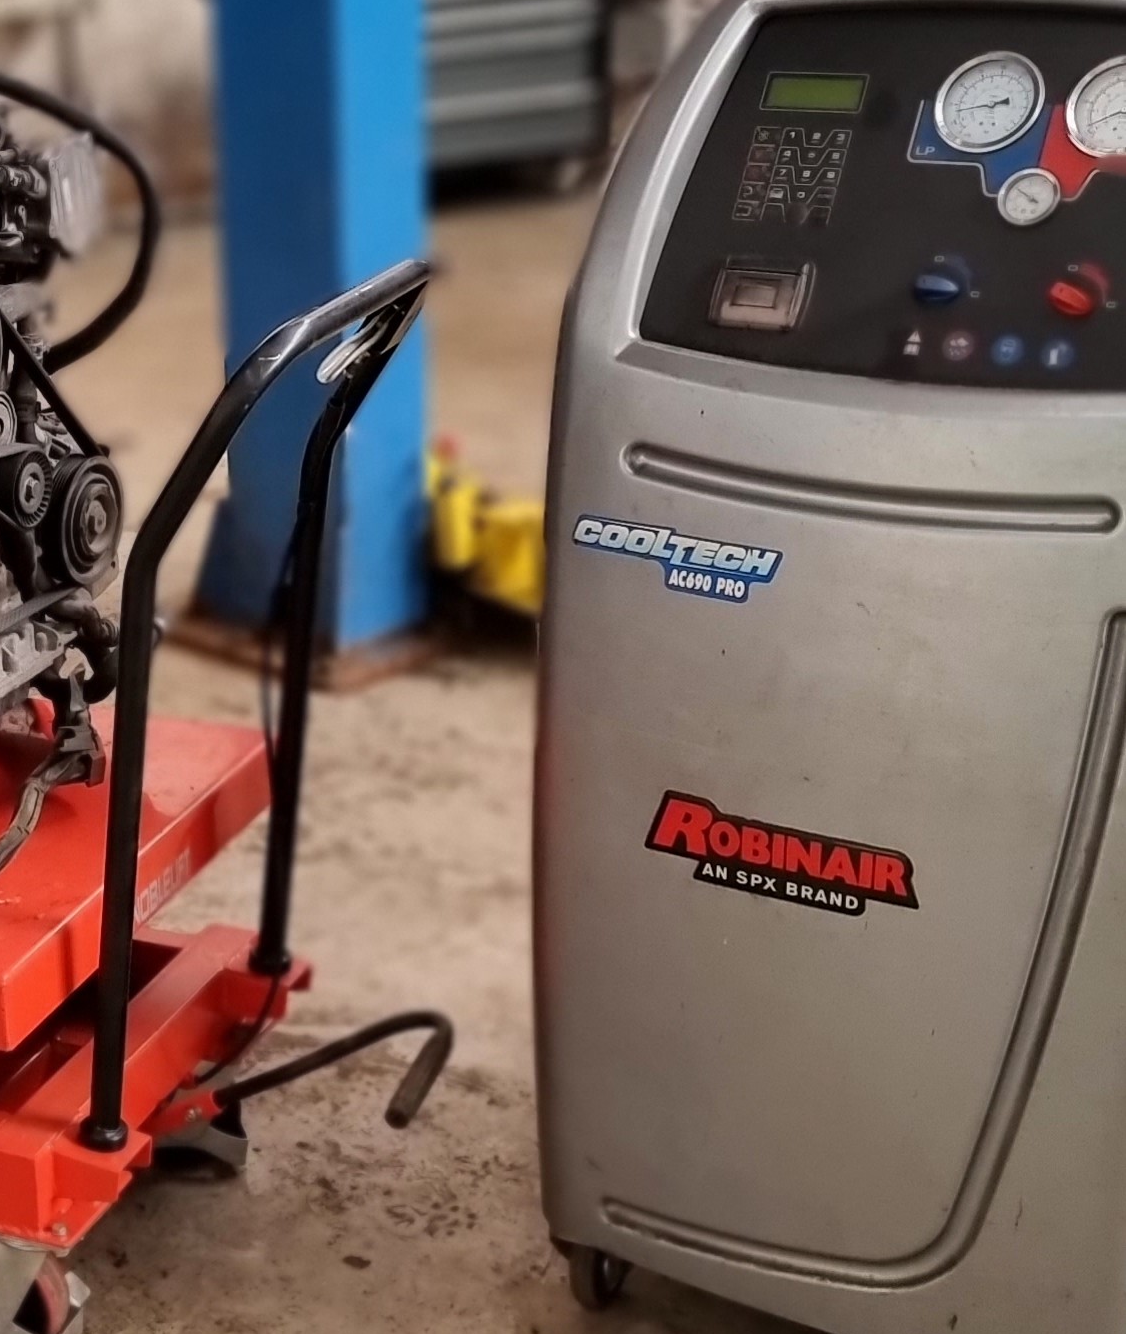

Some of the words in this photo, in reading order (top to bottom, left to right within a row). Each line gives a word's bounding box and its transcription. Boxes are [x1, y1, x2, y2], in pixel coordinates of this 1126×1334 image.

[915, 146, 936, 156] LP
[574, 519, 778, 576] COOLTECH
[668, 569, 712, 592] AC690
[715, 577, 746, 598] PRO
[653, 798, 907, 896] ROBINAIR
[702, 862, 728, 880] AN
[736, 870, 777, 892] SPX
[785, 882, 859, 909] BRAND
